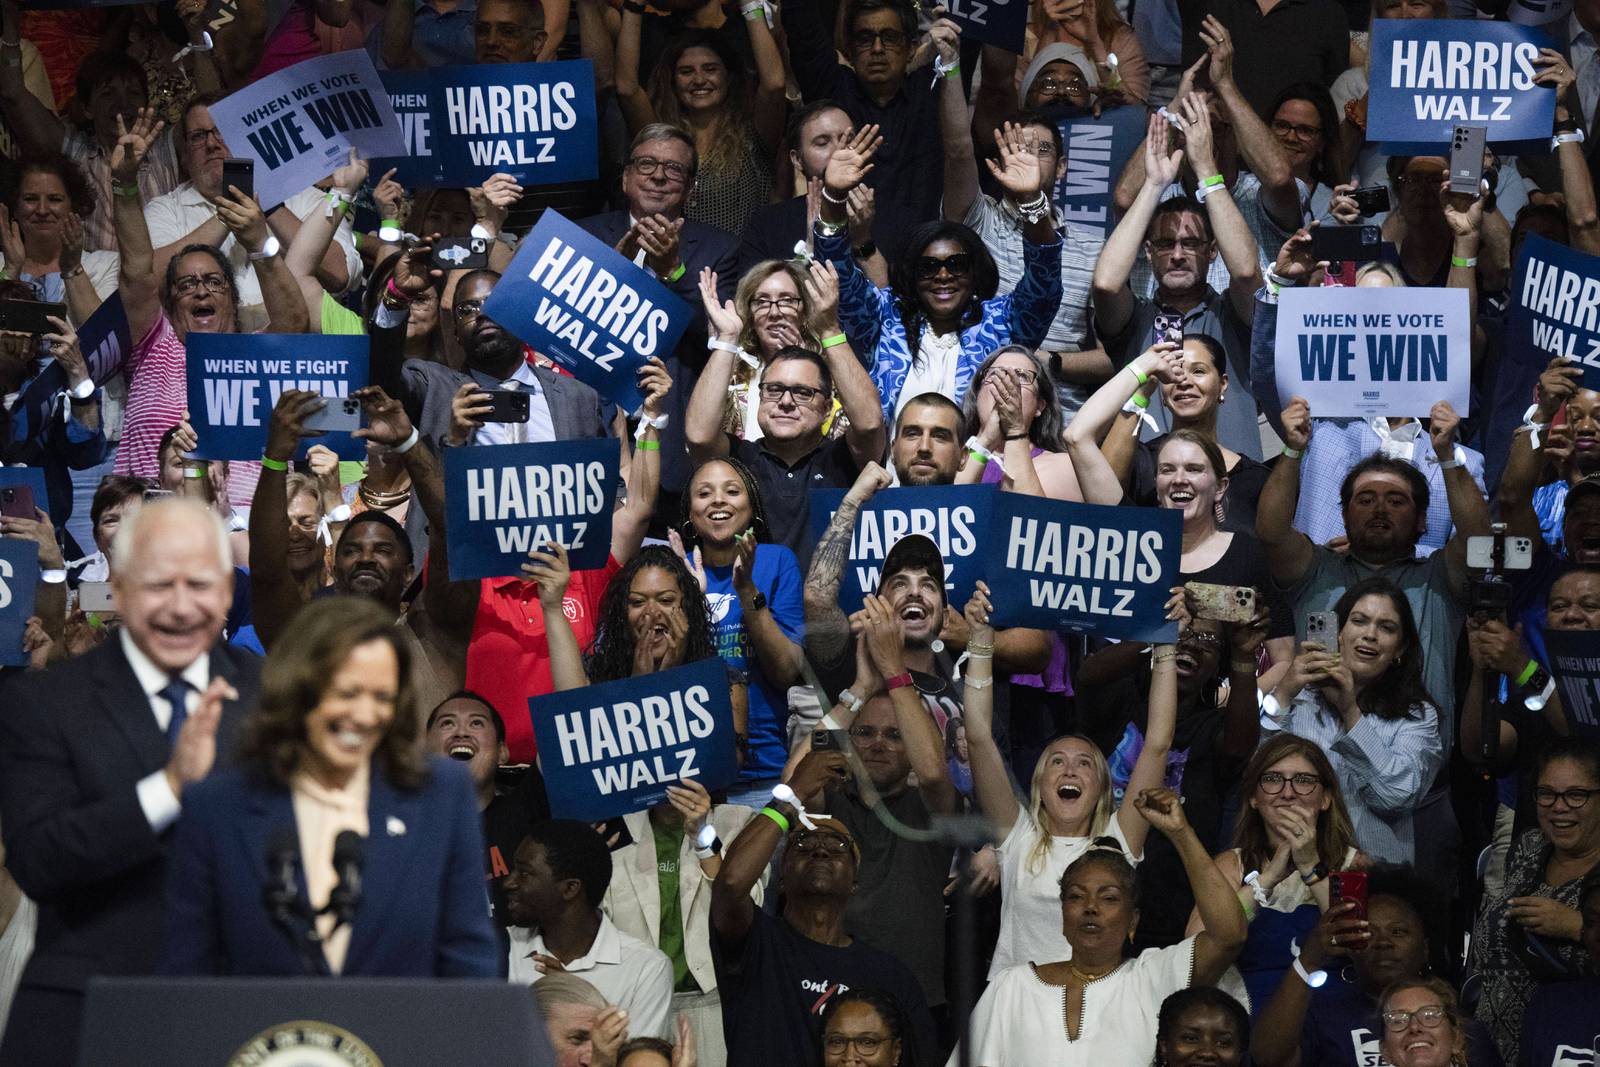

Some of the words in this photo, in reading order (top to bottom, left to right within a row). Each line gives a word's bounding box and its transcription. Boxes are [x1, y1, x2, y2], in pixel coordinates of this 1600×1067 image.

[937, 0, 988, 25] LZ
[1390, 39, 1539, 91] HARRIS
[241, 94, 291, 127] WHEN
[291, 82, 319, 101] WE
[320, 73, 360, 90] VOTE
[445, 81, 577, 135] HARRIS
[1413, 94, 1513, 121] WALZ
[246, 110, 314, 171] WE
[302, 88, 384, 140] WIN
[468, 137, 556, 166] WALZ
[1065, 124, 1114, 196] WIN
[528, 236, 669, 357] HARRIS
[1303, 313, 1357, 328] WHEN
[1362, 313, 1392, 328] WE
[1397, 313, 1444, 328] VOTE
[1521, 256, 1600, 334] HARR
[533, 296, 625, 373] WALZ
[1297, 334, 1357, 382] WE
[1365, 334, 1448, 382] WIN
[1533, 318, 1600, 369] WALZ
[204, 359, 257, 374] WHEN
[262, 360, 291, 374] WE
[296, 360, 349, 375] FIGHT
[203, 378, 261, 427] WE
[466, 461, 606, 521] HARRIS
[495, 521, 588, 554] WALZ
[1006, 516, 1163, 584] HARRIS
[1029, 578, 1136, 617] WALZ
[554, 685, 715, 767] HARRIS
[591, 748, 700, 796] WALZ
